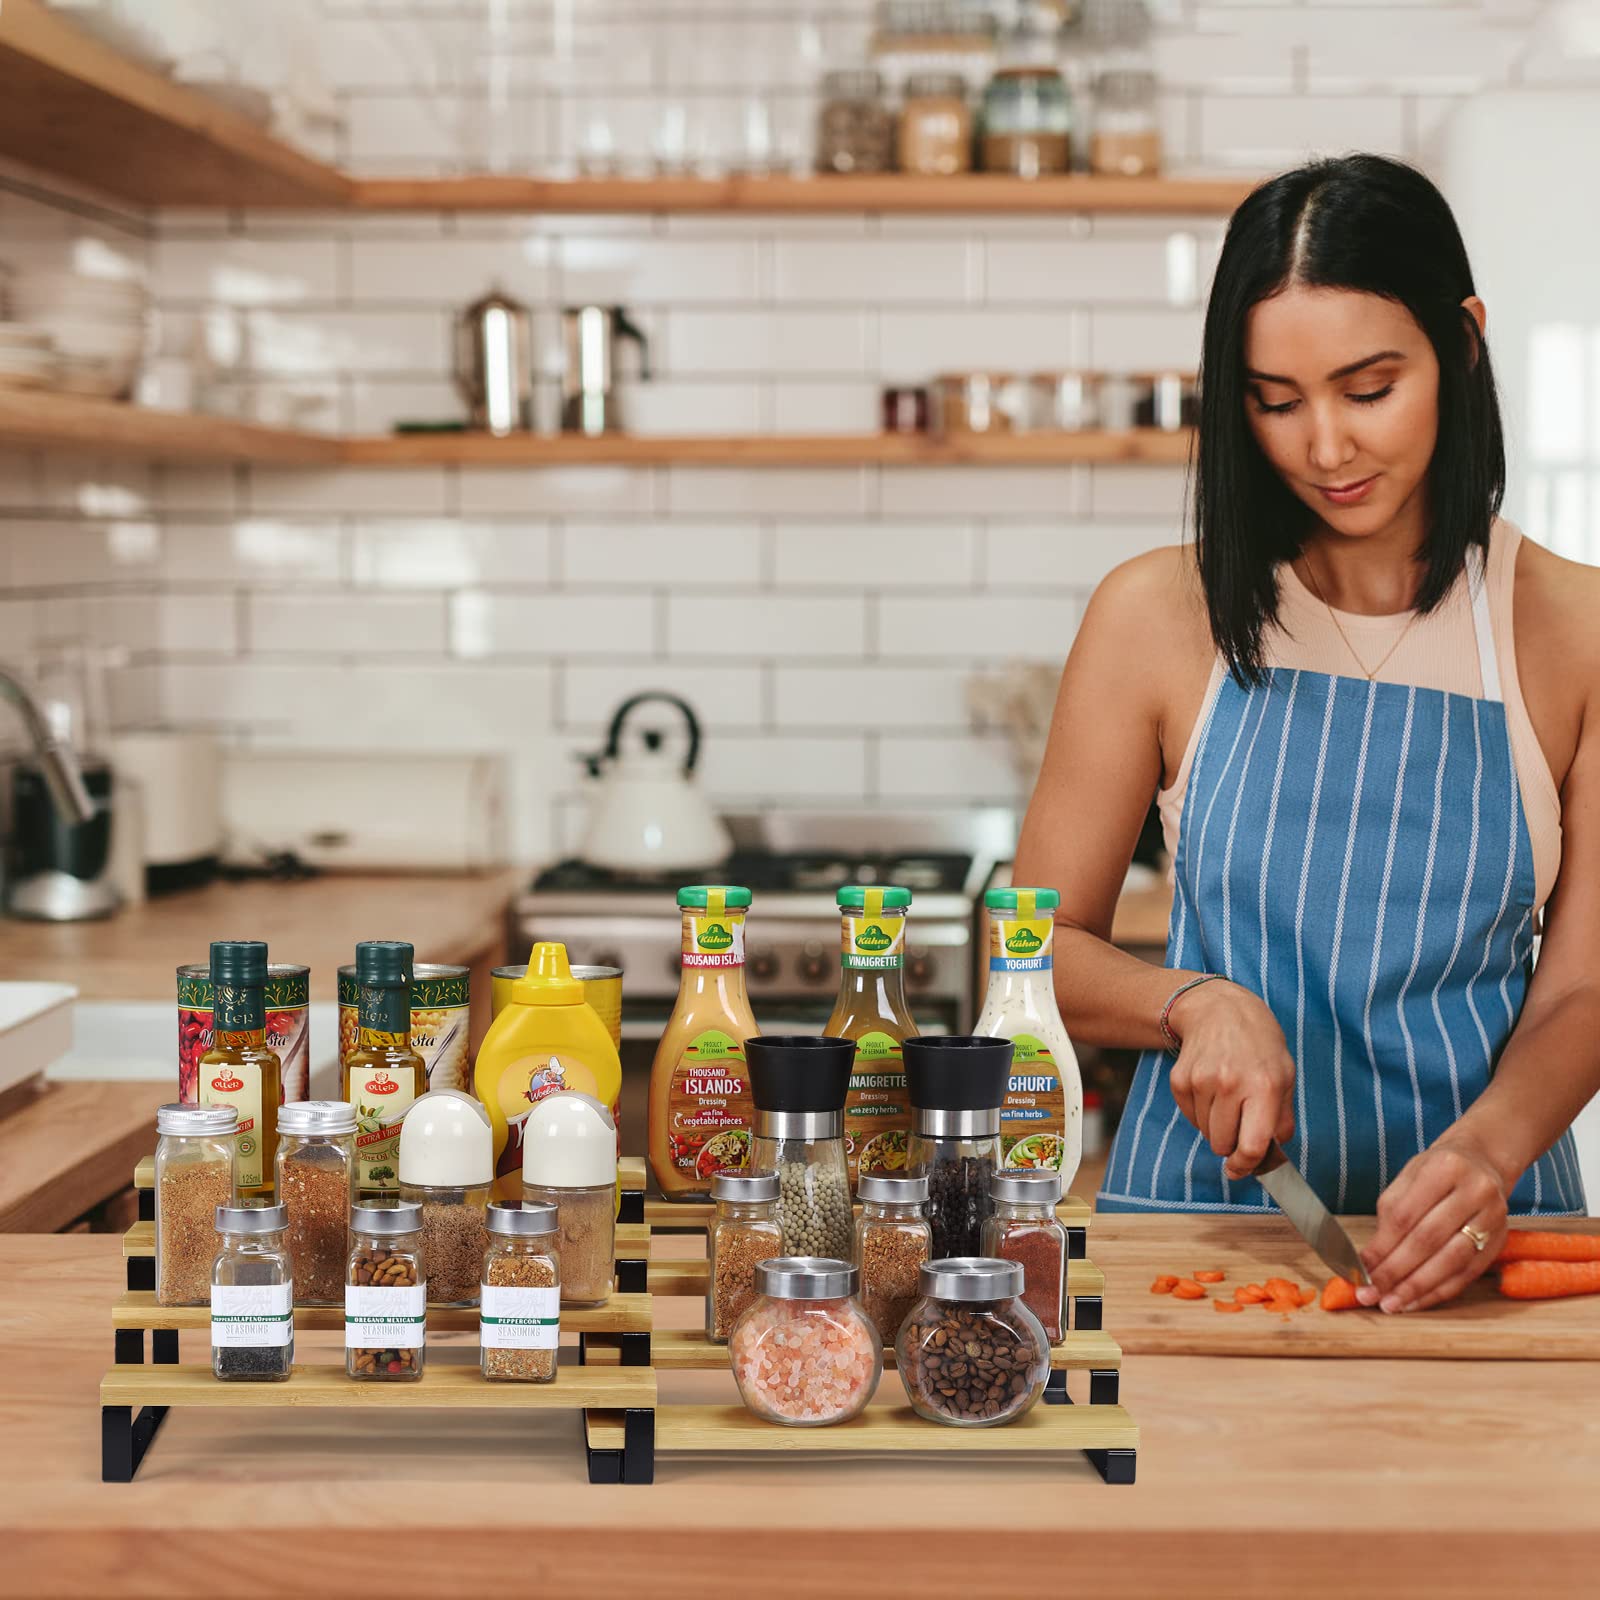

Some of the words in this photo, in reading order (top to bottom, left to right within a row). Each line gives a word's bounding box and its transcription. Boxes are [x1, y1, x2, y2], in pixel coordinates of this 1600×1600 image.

[700, 935, 731, 944] Kühne
[858, 937, 889, 945] Kühne
[1008, 939, 1040, 948] Kühne
[683, 954, 720, 966] THOUSAND
[848, 955, 897, 967] VINAIGRETTE
[1005, 958, 1043, 970] YOGHURT
[215, 1012, 253, 1025] LLER
[689, 1068, 726, 1077] THOUSAND
[685, 1078, 742, 1094] ISLANDS
[849, 1075, 907, 1087] INAIGRETTE
[1008, 1076, 1053, 1092] GHURT
[698, 1097, 727, 1107] Dressing
[860, 1092, 889, 1102] Dressing
[1007, 1096, 1036, 1106] Dressing
[862, 1106, 879, 1115] zesty
[879, 1105, 898, 1113] herbs
[1011, 1109, 1024, 1117] fine
[1024, 1110, 1043, 1118] herbs
[683, 1116, 719, 1127] vegetable
[719, 1116, 743, 1127] pieces
[358, 1132, 380, 1146] EXTRA
[382, 1124, 402, 1138] VIRGI
[376, 1152, 388, 1160] Oil
[225, 1324, 269, 1335] SEASONING
[362, 1325, 406, 1336] SEASONING
[497, 1326, 541, 1337] SEASONING
